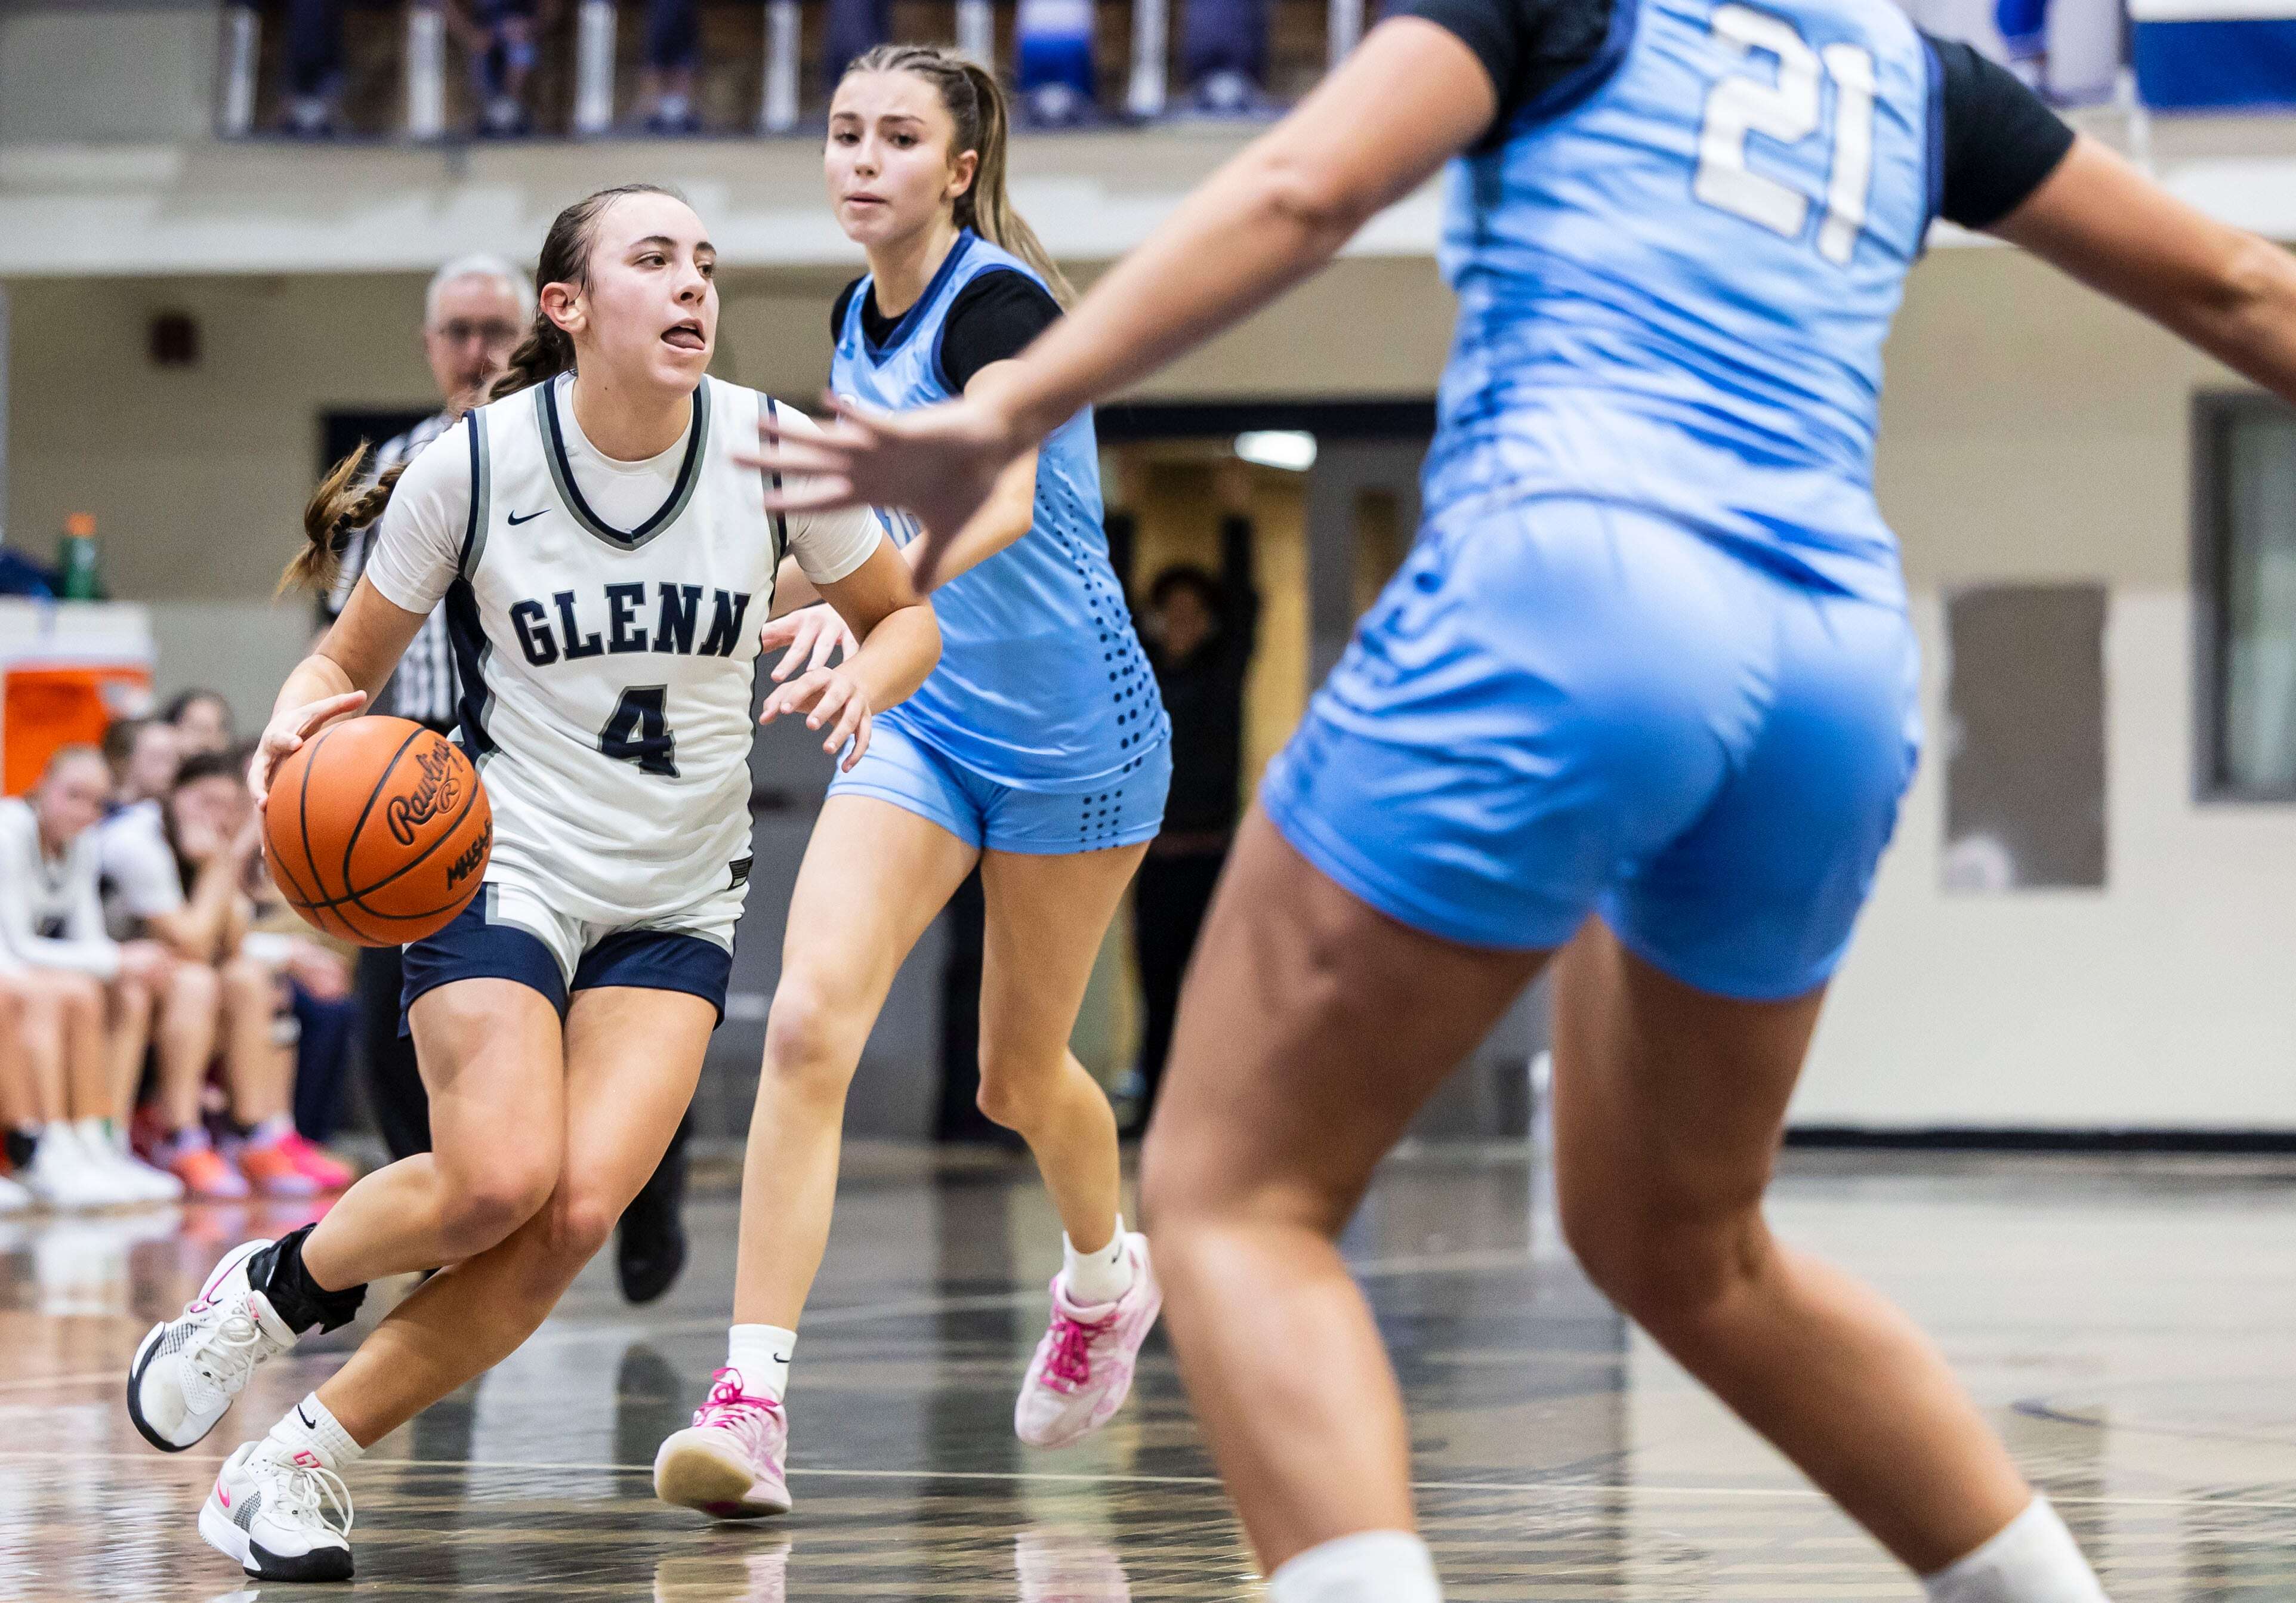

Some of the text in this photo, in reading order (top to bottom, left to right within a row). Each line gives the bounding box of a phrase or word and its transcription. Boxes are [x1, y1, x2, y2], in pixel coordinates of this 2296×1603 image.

[1693, 5, 1876, 266] 21
[508, 581, 752, 667] GLENN
[597, 684, 681, 778] 4
[386, 739, 464, 846] Rawling
